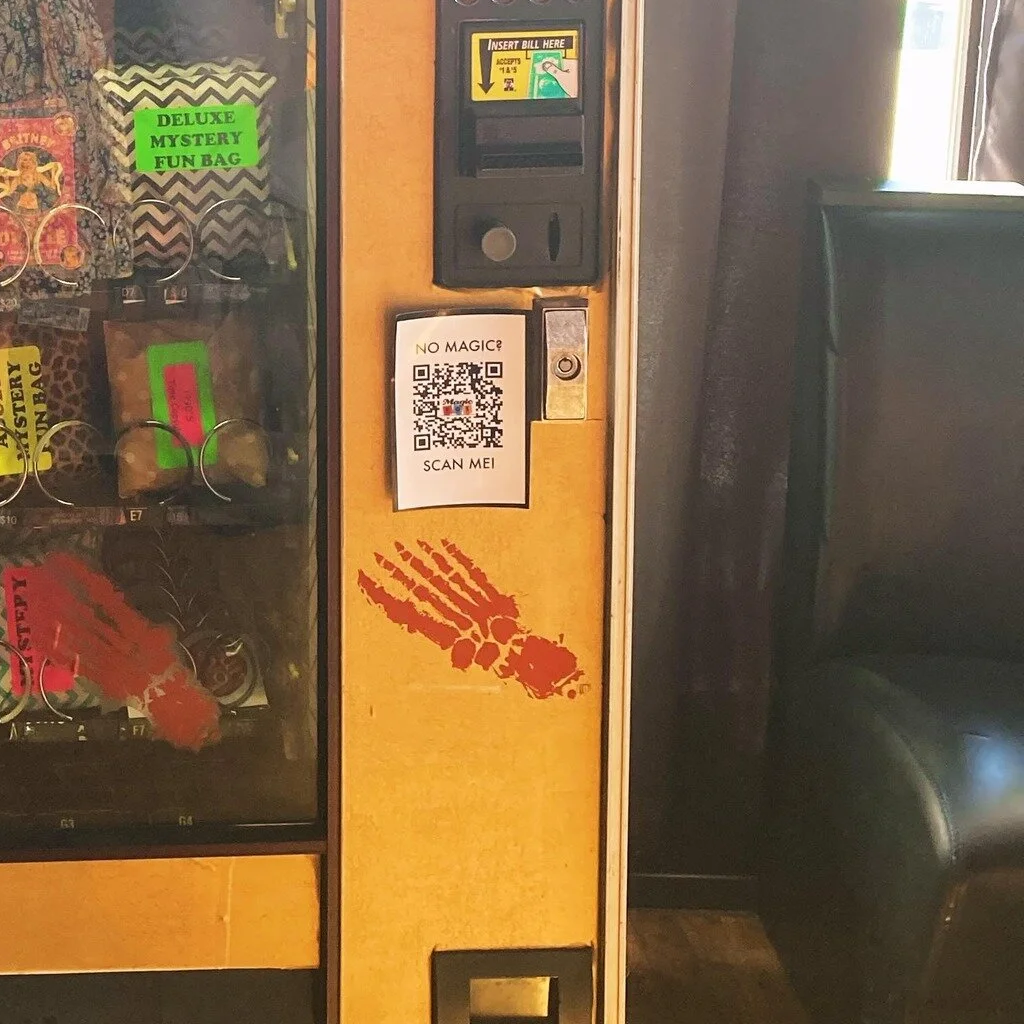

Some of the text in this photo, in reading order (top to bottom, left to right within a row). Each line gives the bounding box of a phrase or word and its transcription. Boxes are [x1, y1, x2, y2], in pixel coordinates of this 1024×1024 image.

[487, 37, 566, 51] INSERT BILL HERE
[495, 57, 522, 66] ACCEPTS
[156, 110, 236, 128] DELUXE
[150, 131, 243, 149] MYSTERY
[154, 152, 242, 169] FUN BAG
[415, 339, 503, 355] NO MAGIC?
[30, 361, 49, 406] BAG
[442, 398, 474, 406] Magic
[6, 360, 31, 461] MYSTERY
[423, 457, 464, 472] SCAN
[0, 515, 18, 526] $10
[129, 509, 143, 522] E7
[132, 722, 146, 736] F7
[178, 815, 194, 827] G4
